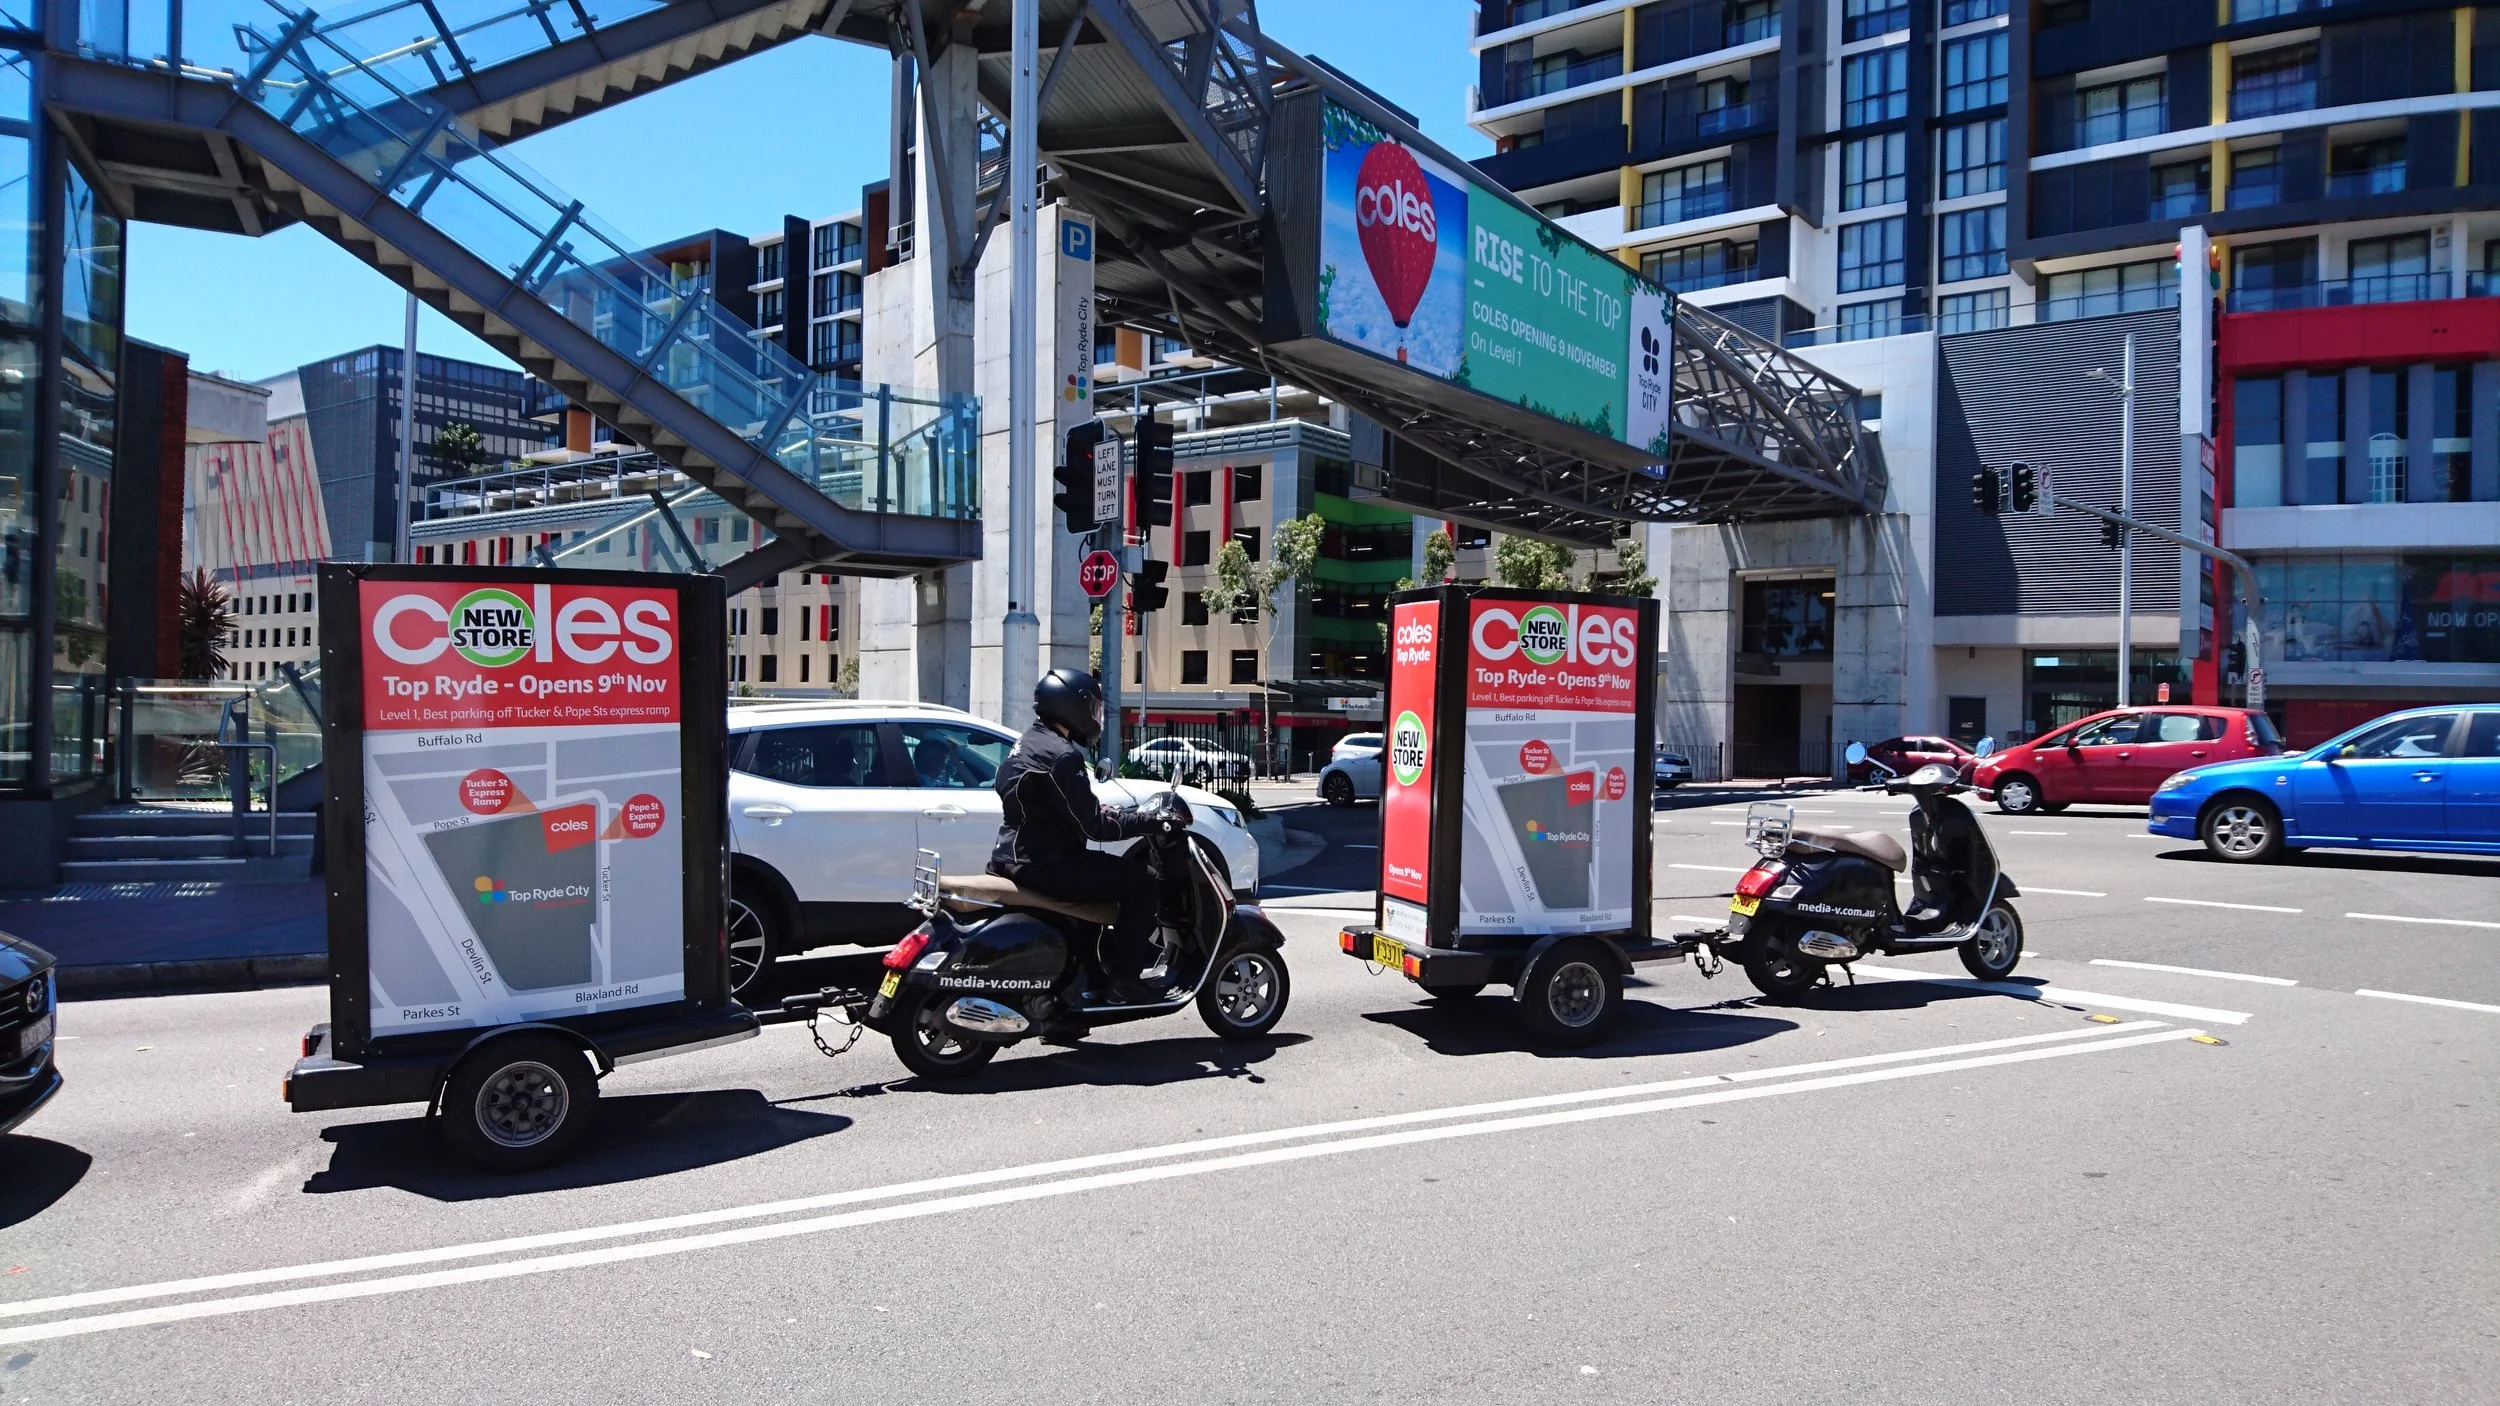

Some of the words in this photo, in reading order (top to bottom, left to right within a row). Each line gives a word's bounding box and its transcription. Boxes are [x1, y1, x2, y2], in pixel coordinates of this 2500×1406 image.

[1357, 180, 1436, 243] coles
[1069, 226, 1086, 253] P
[1475, 225, 1523, 285] RISE
[1530, 254, 1551, 297] TO
[1557, 269, 1587, 316] THE
[1594, 288, 1621, 331] TOP
[1078, 297, 1089, 321] City
[1078, 323, 1089, 353] Ryde
[1473, 301, 1508, 332] COLES
[1511, 318, 1556, 353] OPENING
[1559, 340, 1565, 356] 9
[1567, 343, 1617, 380] NOVEMBER
[1471, 332, 1486, 353] On
[1489, 339, 1515, 365] Level
[1517, 350, 1522, 367] 1
[1078, 355, 1088, 373] Top
[1638, 374, 1648, 390] Top
[1648, 378, 1661, 394] Ryde
[1642, 391, 1657, 412] CITY
[1098, 447, 1115, 460] LEFT
[1097, 461, 1116, 474] LANE
[1097, 475, 1116, 488] MUST
[1097, 490, 1116, 502] TURN
[1098, 504, 1115, 515] LEFT
[1083, 565, 1115, 581] STOP
[464, 608, 523, 628] NEW
[2428, 612, 2467, 627] NOW
[2475, 612, 2500, 627] OP
[1397, 617, 1432, 645] coles
[1527, 621, 1562, 635] NEW
[453, 627, 534, 649] STORE
[1521, 635, 1567, 650] STORE
[1396, 648, 1408, 666] Top
[1408, 646, 1431, 666] Ryde
[1475, 668, 1504, 687] Top
[1508, 669, 1546, 688] Ryde
[1558, 671, 1596, 690] Opens
[1598, 673, 1611, 687] 9th
[1612, 675, 1631, 689] Nov
[383, 676, 428, 701] Top
[435, 674, 498, 700] Ryde
[519, 674, 594, 699] Opens
[598, 673, 624, 693] 9th
[627, 674, 667, 693] Nov
[1472, 692, 1492, 701] Level
[1500, 693, 1515, 703] Best
[1516, 694, 1543, 705] parking
[1544, 694, 1554, 703] off
[1555, 695, 1574, 704] Tucker
[1575, 696, 1580, 704] &
[1581, 697, 1594, 707] Pope
[380, 709, 410, 720] Level
[424, 708, 447, 720] Best
[451, 708, 494, 722] parking
[497, 707, 513, 718] off
[515, 707, 550, 718] Tucker
[553, 706, 563, 717] &
[565, 706, 590, 719] Pope
[593, 705, 607, 716] Sts
[610, 705, 644, 718] express
[646, 706, 670, 717] ramp
[1495, 713, 1524, 722] Buffalo
[1525, 713, 1536, 721] Rd
[418, 735, 462, 747] Buffalo
[466, 733, 482, 743] Rd
[1397, 730, 1420, 748] NEW
[1393, 749, 1424, 768] STORE
[1525, 754, 1548, 762] Express
[1527, 761, 1545, 769] Ramp
[465, 780, 497, 788] Tucker
[498, 779, 508, 787] St
[1571, 782, 1591, 791] coles
[469, 788, 505, 798] Express
[473, 798, 501, 807] Ramp
[629, 803, 650, 813] Pope
[434, 819, 458, 830] Pope
[460, 817, 470, 825] St
[629, 812, 660, 822] Express
[551, 820, 588, 832] coles
[632, 821, 657, 830] Ramp
[1546, 832, 1559, 842] Top
[1560, 832, 1577, 842] Ryde
[1577, 832, 1590, 842] City
[602, 866, 610, 892] Tucker
[1388, 864, 1404, 877] Opens
[1411, 869, 1422, 880] Nov
[1517, 866, 1530, 892] Devlin
[1527, 892, 1535, 902] St
[509, 890, 531, 902] Top
[533, 887, 565, 900] Ryde
[566, 885, 590, 898] City
[602, 893, 611, 902] St
[1798, 903, 1875, 917] media-v.com.au
[1480, 915, 1505, 923] Parkes
[1507, 915, 1515, 923] St
[1580, 914, 1604, 923] Blaxland
[461, 938, 484, 973] Devlin
[479, 972, 492, 985] St
[939, 975, 1051, 989] media-v.com.au
[576, 987, 622, 1003] Blaxland
[625, 984, 639, 996] Rd
[403, 1006, 444, 1020] Parkes
[447, 1005, 460, 1016] St
